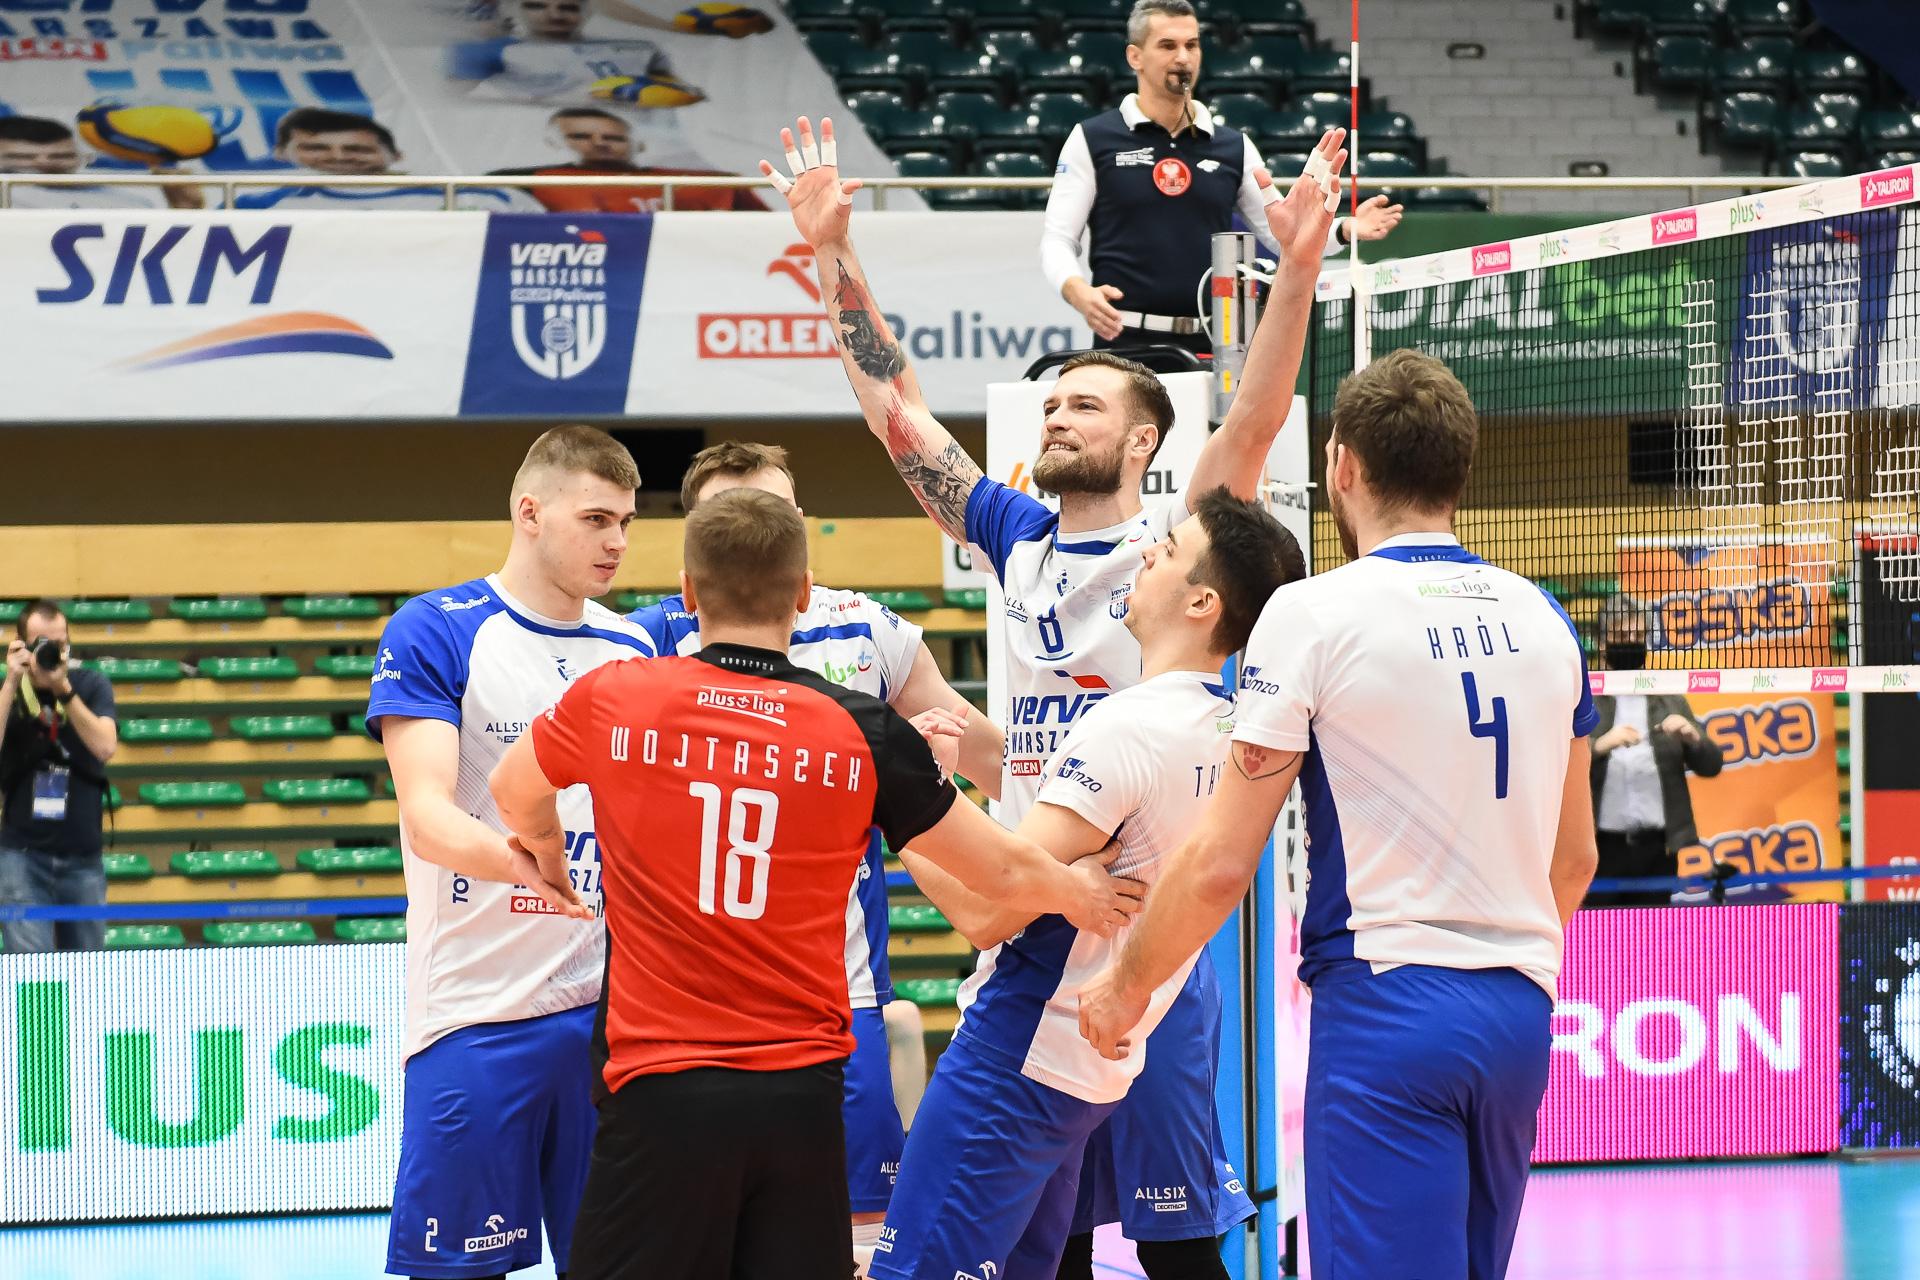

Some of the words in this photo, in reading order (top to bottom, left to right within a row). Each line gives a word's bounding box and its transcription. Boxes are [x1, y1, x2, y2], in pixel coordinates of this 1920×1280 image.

[1876, 175, 1910, 197] TAURON
[1665, 216, 1694, 235] TAURON
[1730, 200, 1755, 232] plus
[510, 243, 608, 267] verva
[1539, 235, 1560, 264] plus
[36, 225, 294, 305] SKM
[1462, 581, 1491, 594] liga
[1037, 602, 1065, 654] 8
[1660, 583, 1809, 648] eska
[1426, 615, 1520, 659] KRÓL
[824, 661, 857, 683] lus
[1634, 671, 1651, 693] plus
[1752, 670, 1770, 692] plus
[1822, 674, 1845, 686] TAURON
[1882, 668, 1902, 692] plus
[697, 689, 735, 707] plus
[752, 694, 785, 715] liga
[1012, 730, 1070, 754] WARSZ
[1461, 672, 1508, 799] 4
[1705, 703, 1814, 763] ska
[611, 726, 862, 792] WOJTASZEK
[1011, 761, 1039, 775] ORLEN
[688, 780, 780, 921] 18
[1551, 991, 1801, 1079] RON
[17, 980, 381, 1154] lus
[1135, 1185, 1187, 1200] ALLSIX
[425, 1217, 438, 1252] 2
[467, 1236, 504, 1250] ORLEN
